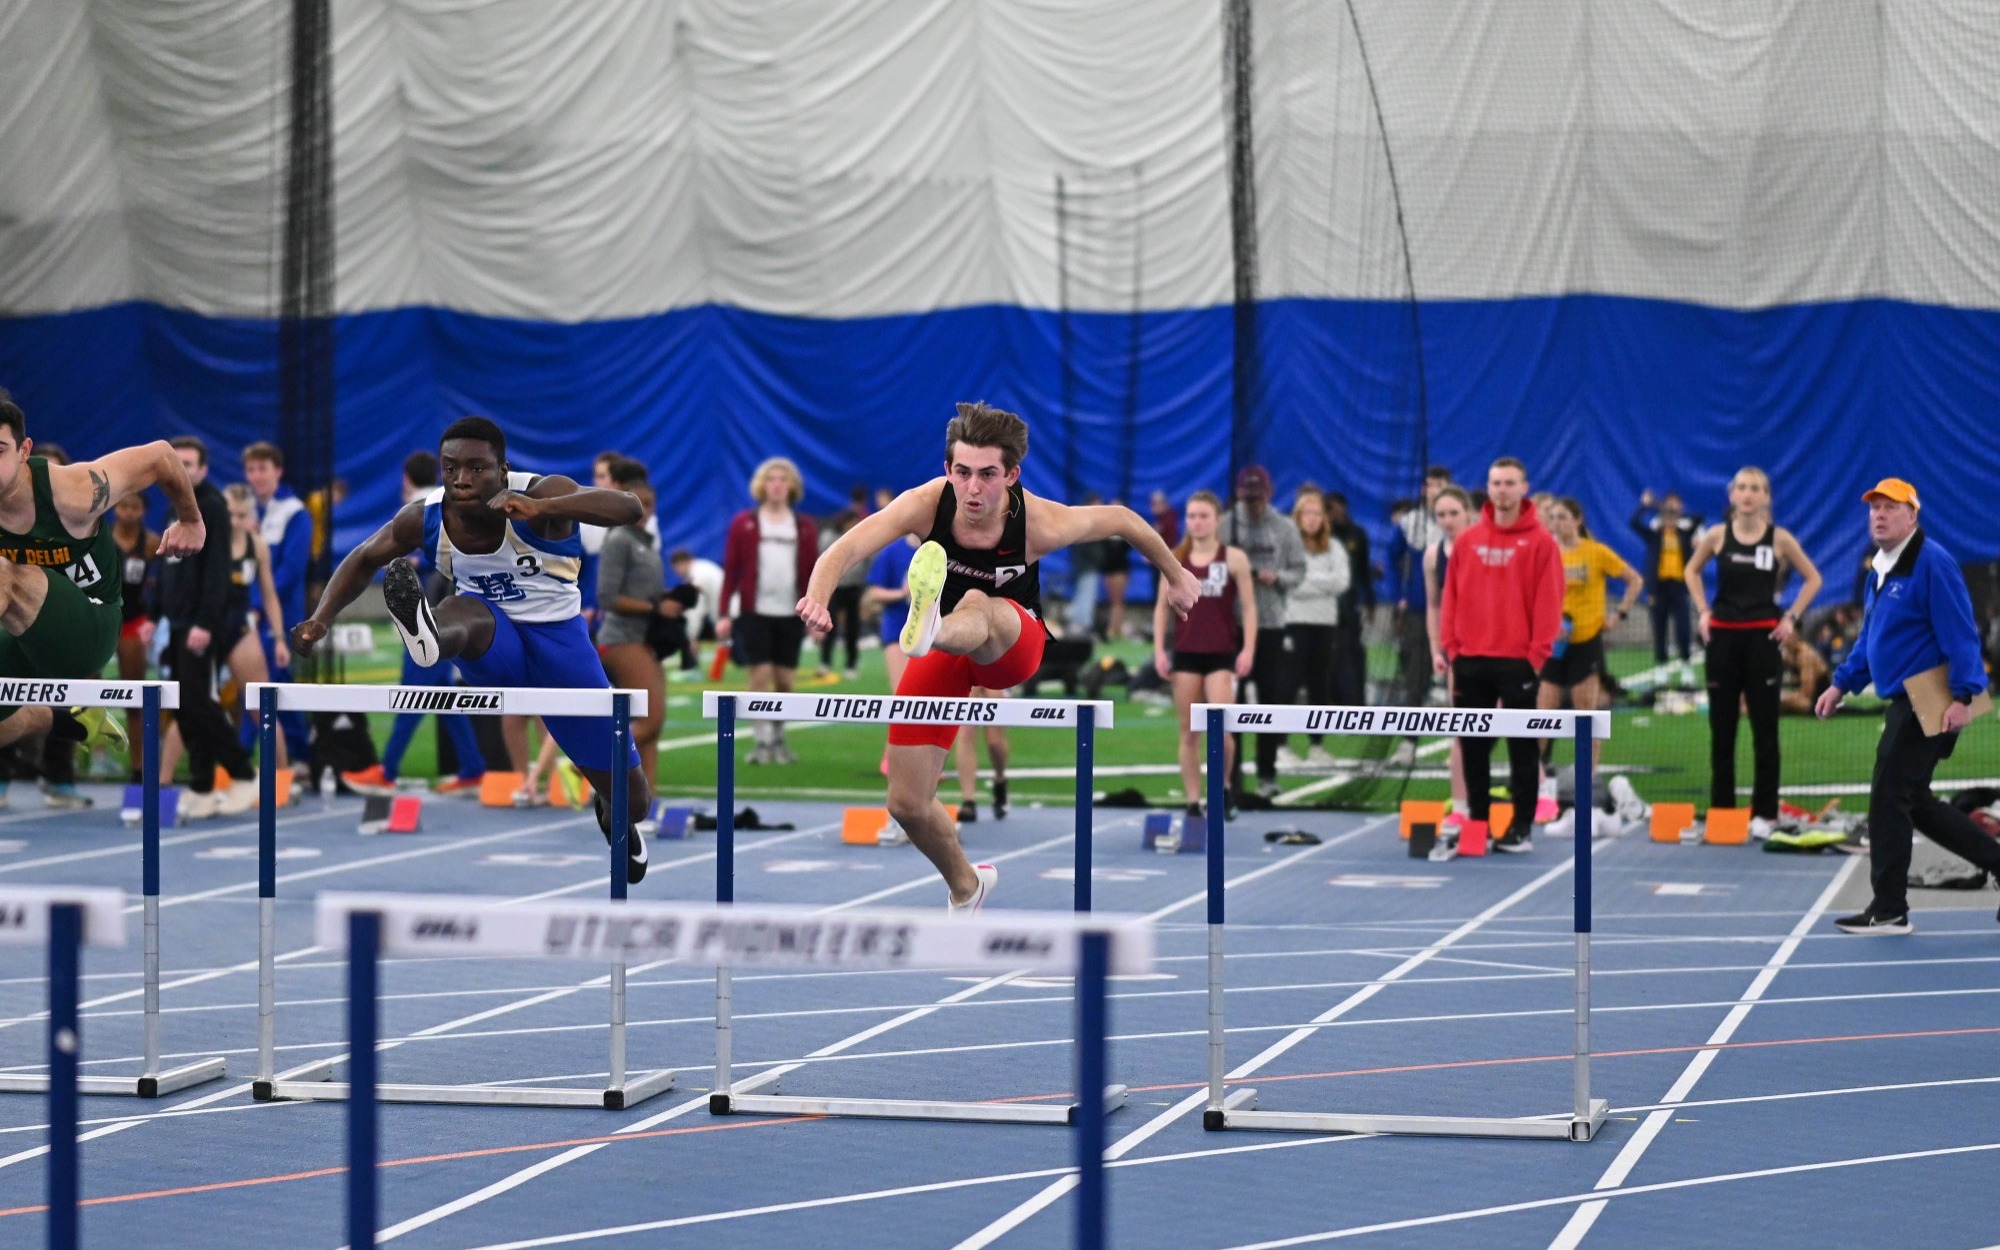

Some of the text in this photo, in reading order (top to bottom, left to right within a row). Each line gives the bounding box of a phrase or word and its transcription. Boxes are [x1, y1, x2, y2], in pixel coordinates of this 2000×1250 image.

[25, 546, 71, 566] DELHI
[74, 557, 95, 583] 4
[517, 555, 541, 577] 3
[1002, 568, 1019, 581] 2
[0, 682, 68, 702] NEERS
[100, 689, 134, 700] GILL
[456, 695, 499, 708] GILL
[748, 701, 783, 712] GILL
[815, 698, 998, 721] UTICA PIONEERS
[1030, 708, 1065, 719] GILL
[1237, 713, 1272, 724] GILL
[1306, 710, 1493, 732] UTICA PIONEERS
[1526, 718, 1562, 730] GILL
